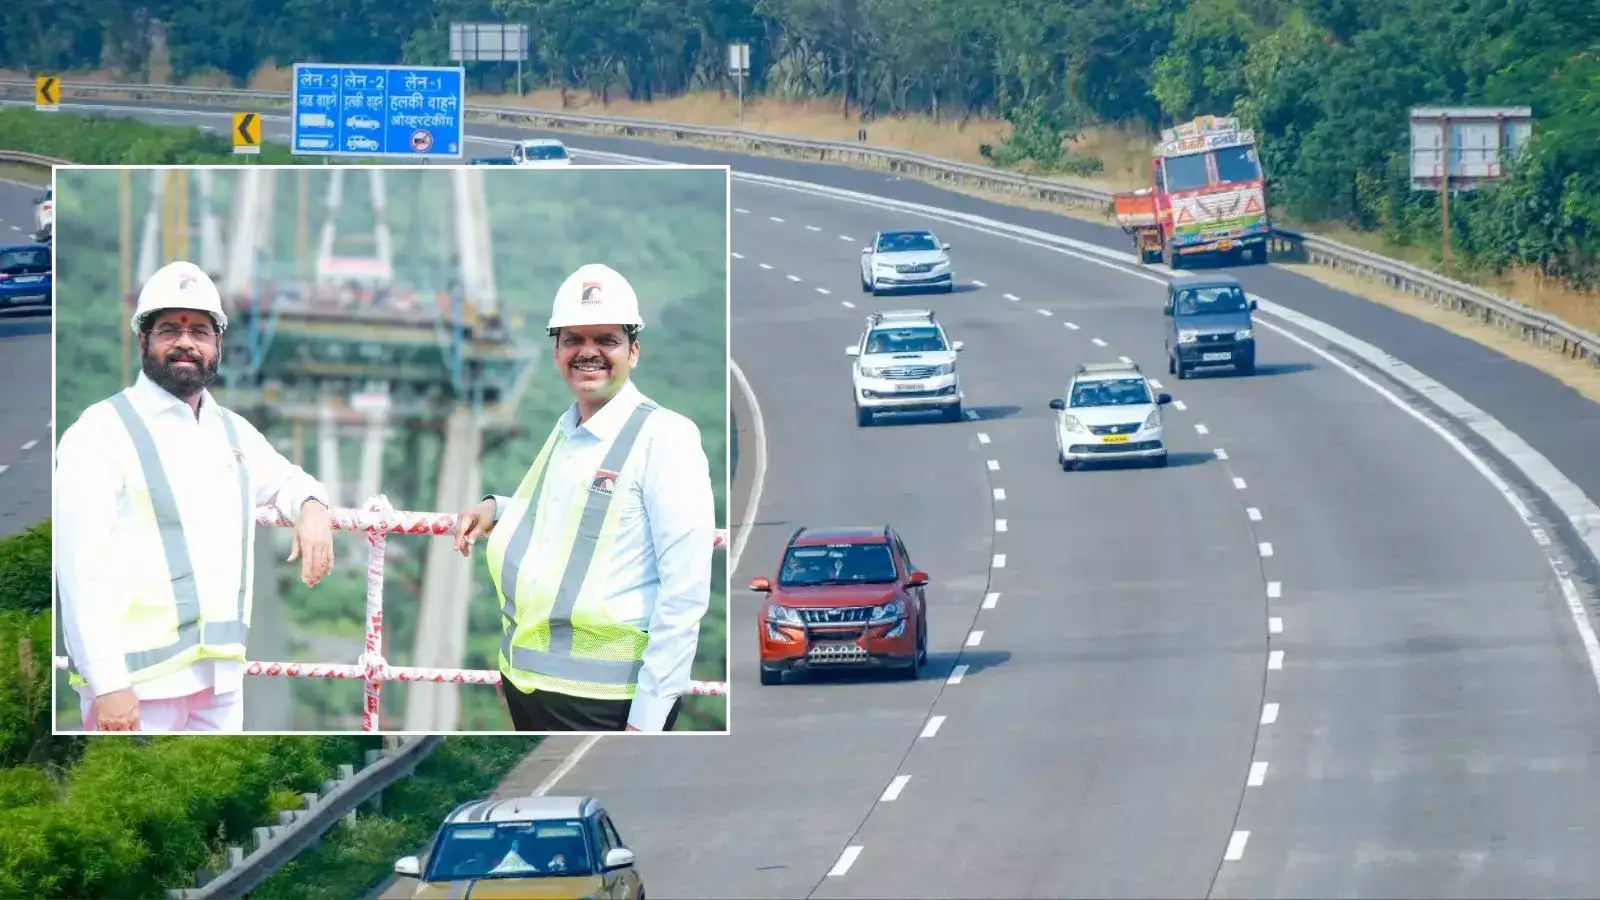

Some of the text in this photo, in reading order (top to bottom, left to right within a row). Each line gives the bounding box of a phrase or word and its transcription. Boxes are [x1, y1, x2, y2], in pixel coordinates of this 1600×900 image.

[299, 69, 323, 87] लेन
[344, 70, 367, 88] लेन
[405, 72, 428, 90] लेन
[428, 93, 457, 113] वाहने
